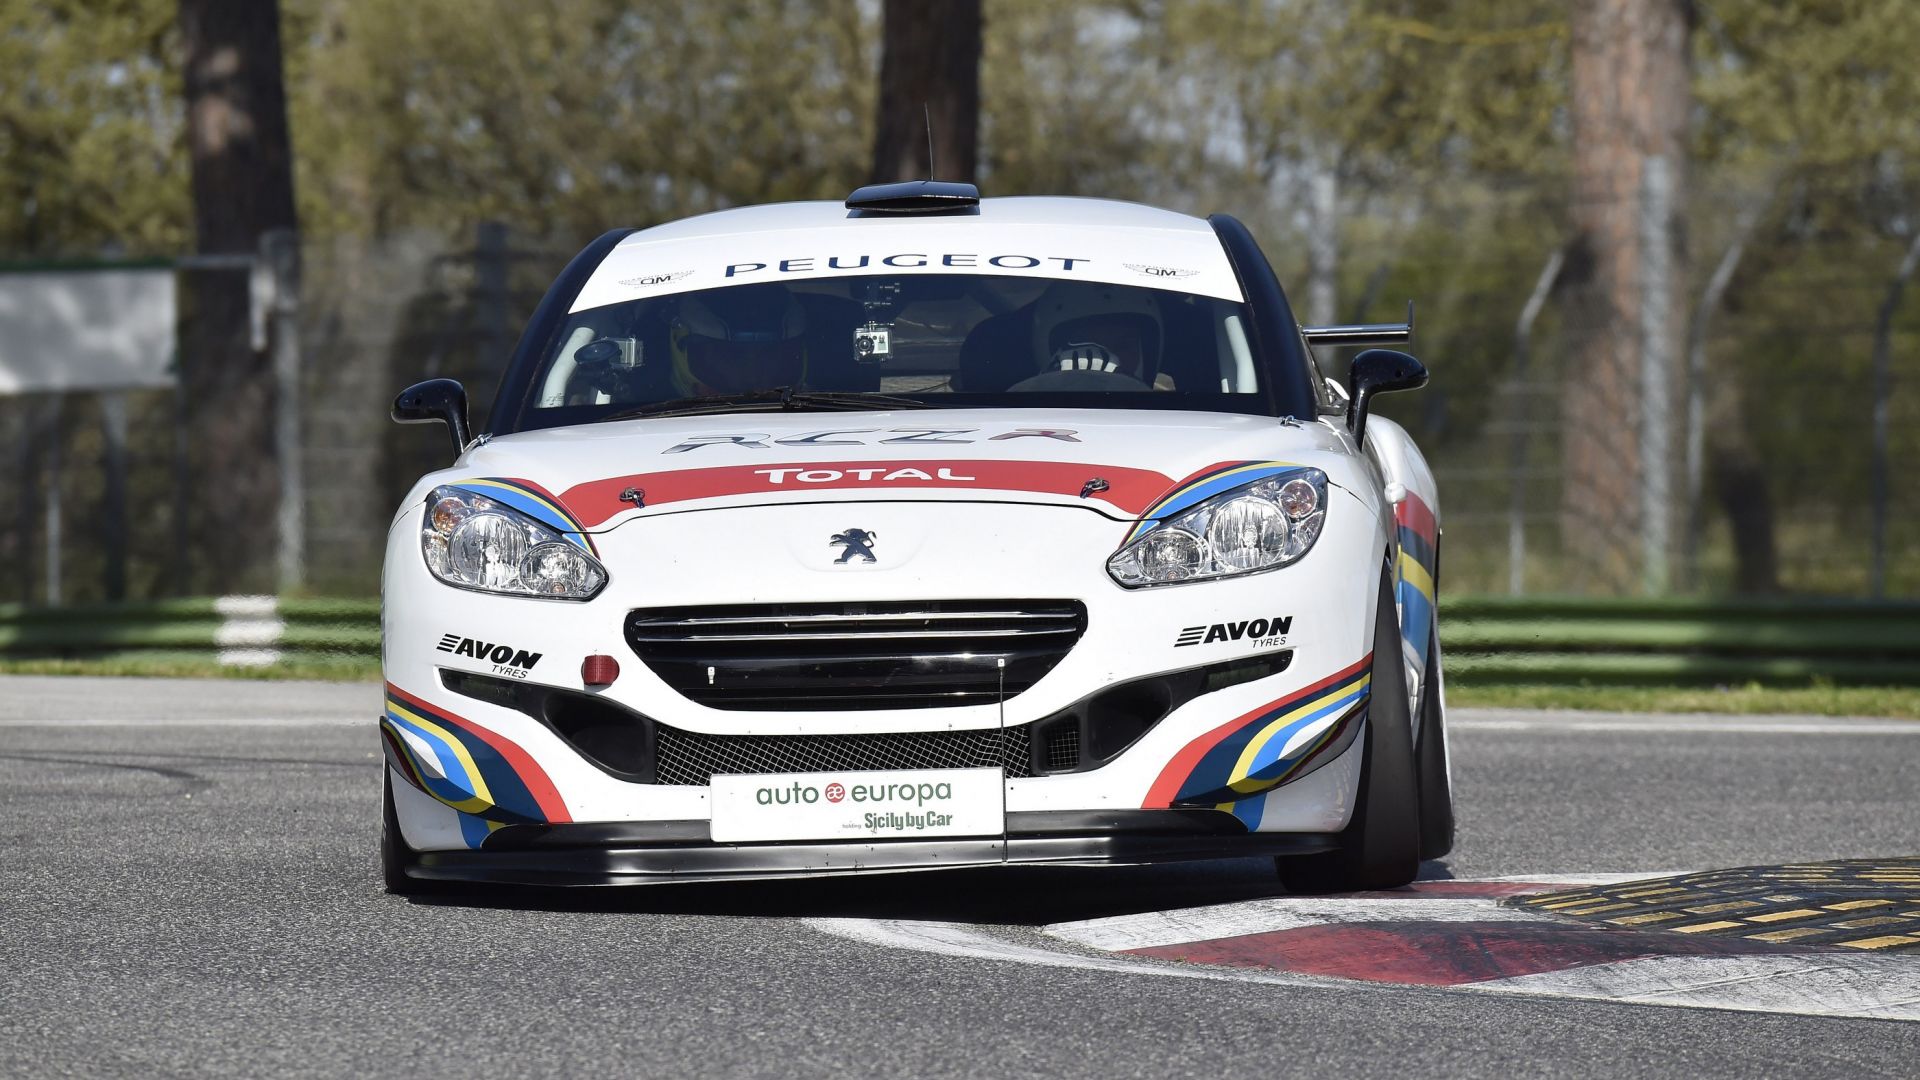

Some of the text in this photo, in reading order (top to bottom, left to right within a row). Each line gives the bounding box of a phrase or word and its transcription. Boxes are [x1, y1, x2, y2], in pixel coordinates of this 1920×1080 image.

[725, 254, 1091, 277] PEUGEOT
[754, 467, 976, 484] TOTAL
[1203, 615, 1293, 644] AVON
[1252, 636, 1287, 648] TYRES
[454, 638, 543, 670] AVON
[491, 664, 529, 679] TYRES
[756, 781, 820, 806] auto
[851, 783, 952, 807] europa
